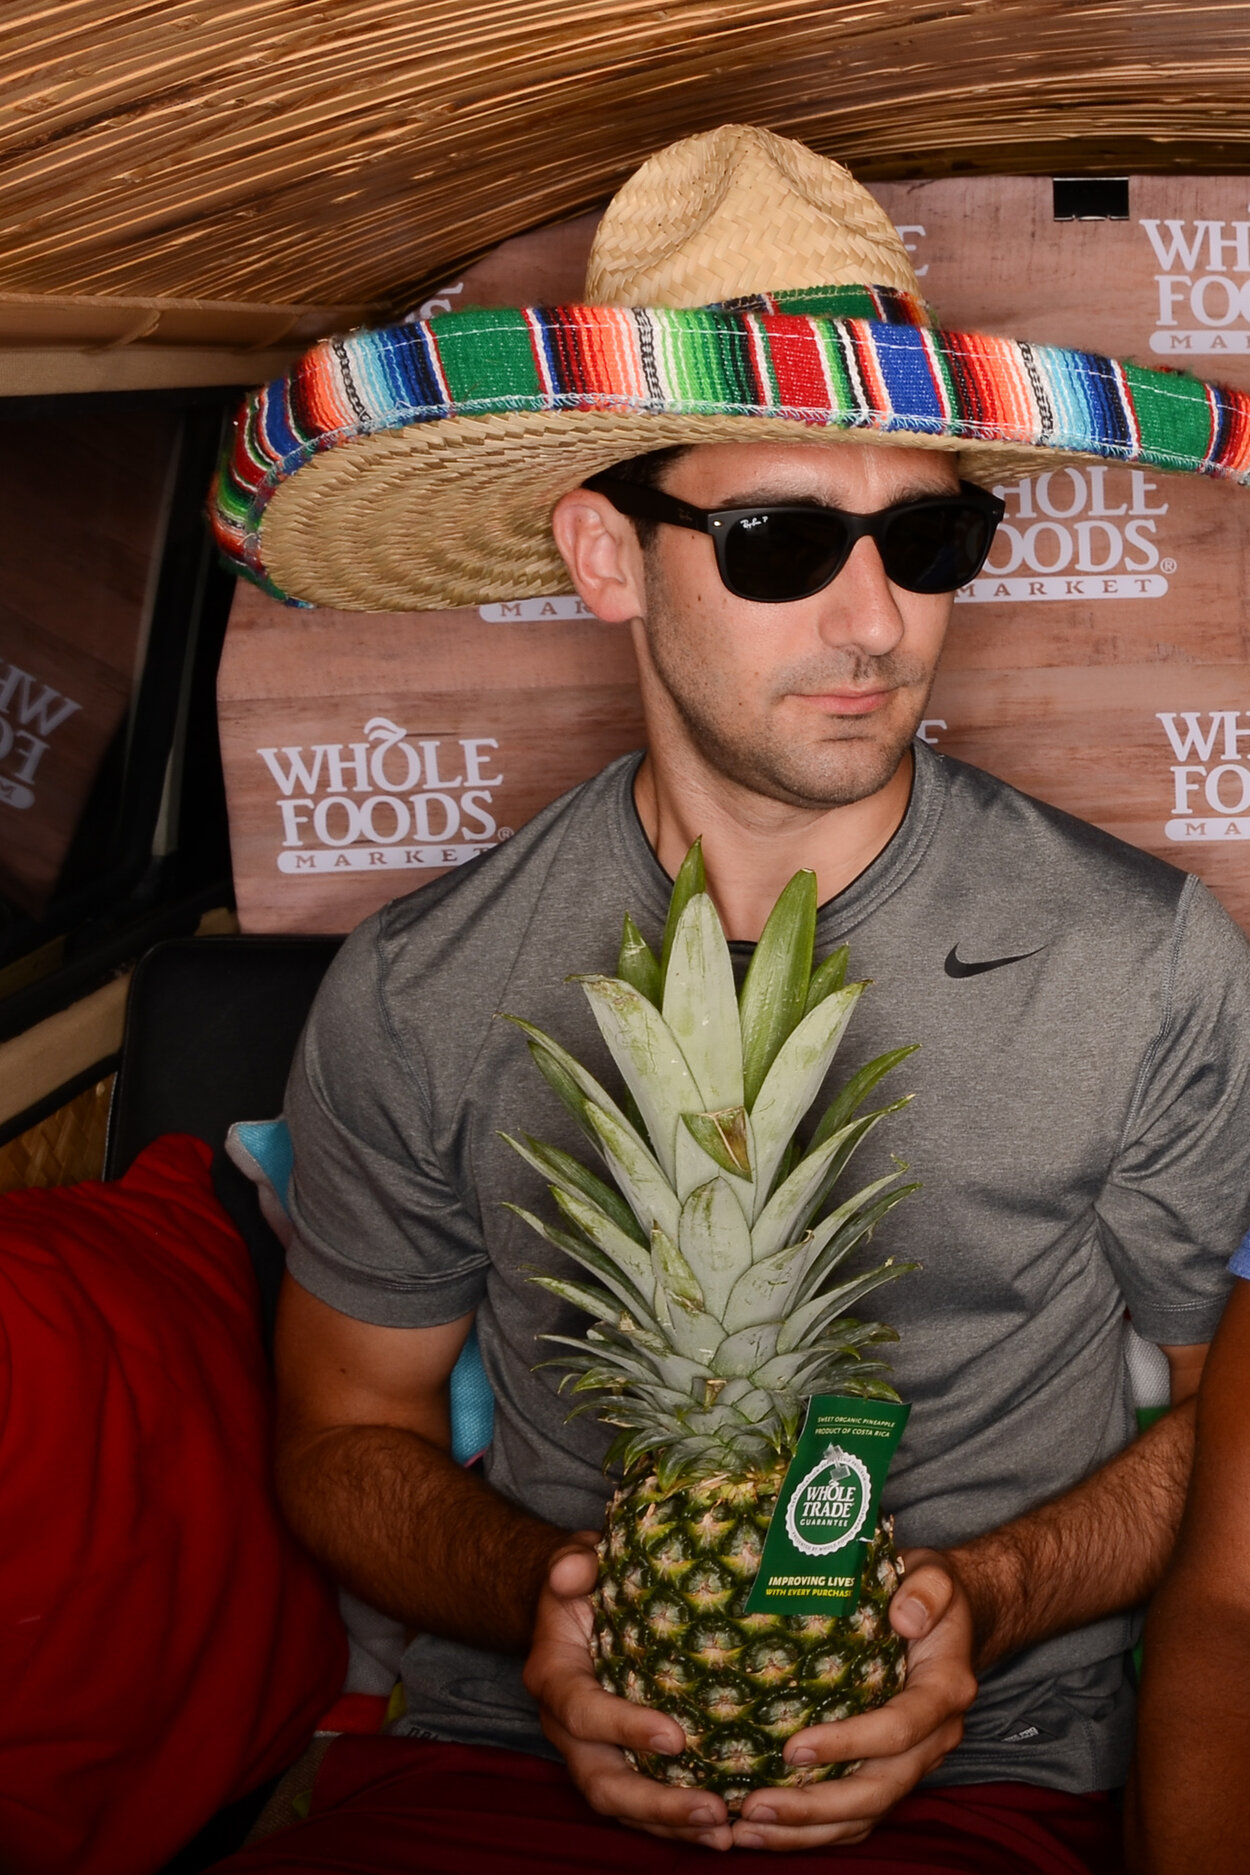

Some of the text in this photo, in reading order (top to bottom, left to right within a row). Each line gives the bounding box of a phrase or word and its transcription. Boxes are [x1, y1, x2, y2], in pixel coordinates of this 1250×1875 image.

[954, 579, 1152, 598] MARKET
[257, 717, 504, 796] WHOLE
[834, 1416, 862, 1424] ORGANIC
[862, 1418, 895, 1428] PINEAPPLE
[852, 1428, 872, 1436] COSTA
[806, 1480, 856, 1502] WHOLE
[802, 1501, 854, 1518] TRADE
[800, 1518, 848, 1527] GUARANTEE
[768, 1576, 826, 1586] IMPROVING
[765, 1588, 786, 1596] WITH
[787, 1588, 811, 1596] EVERY
